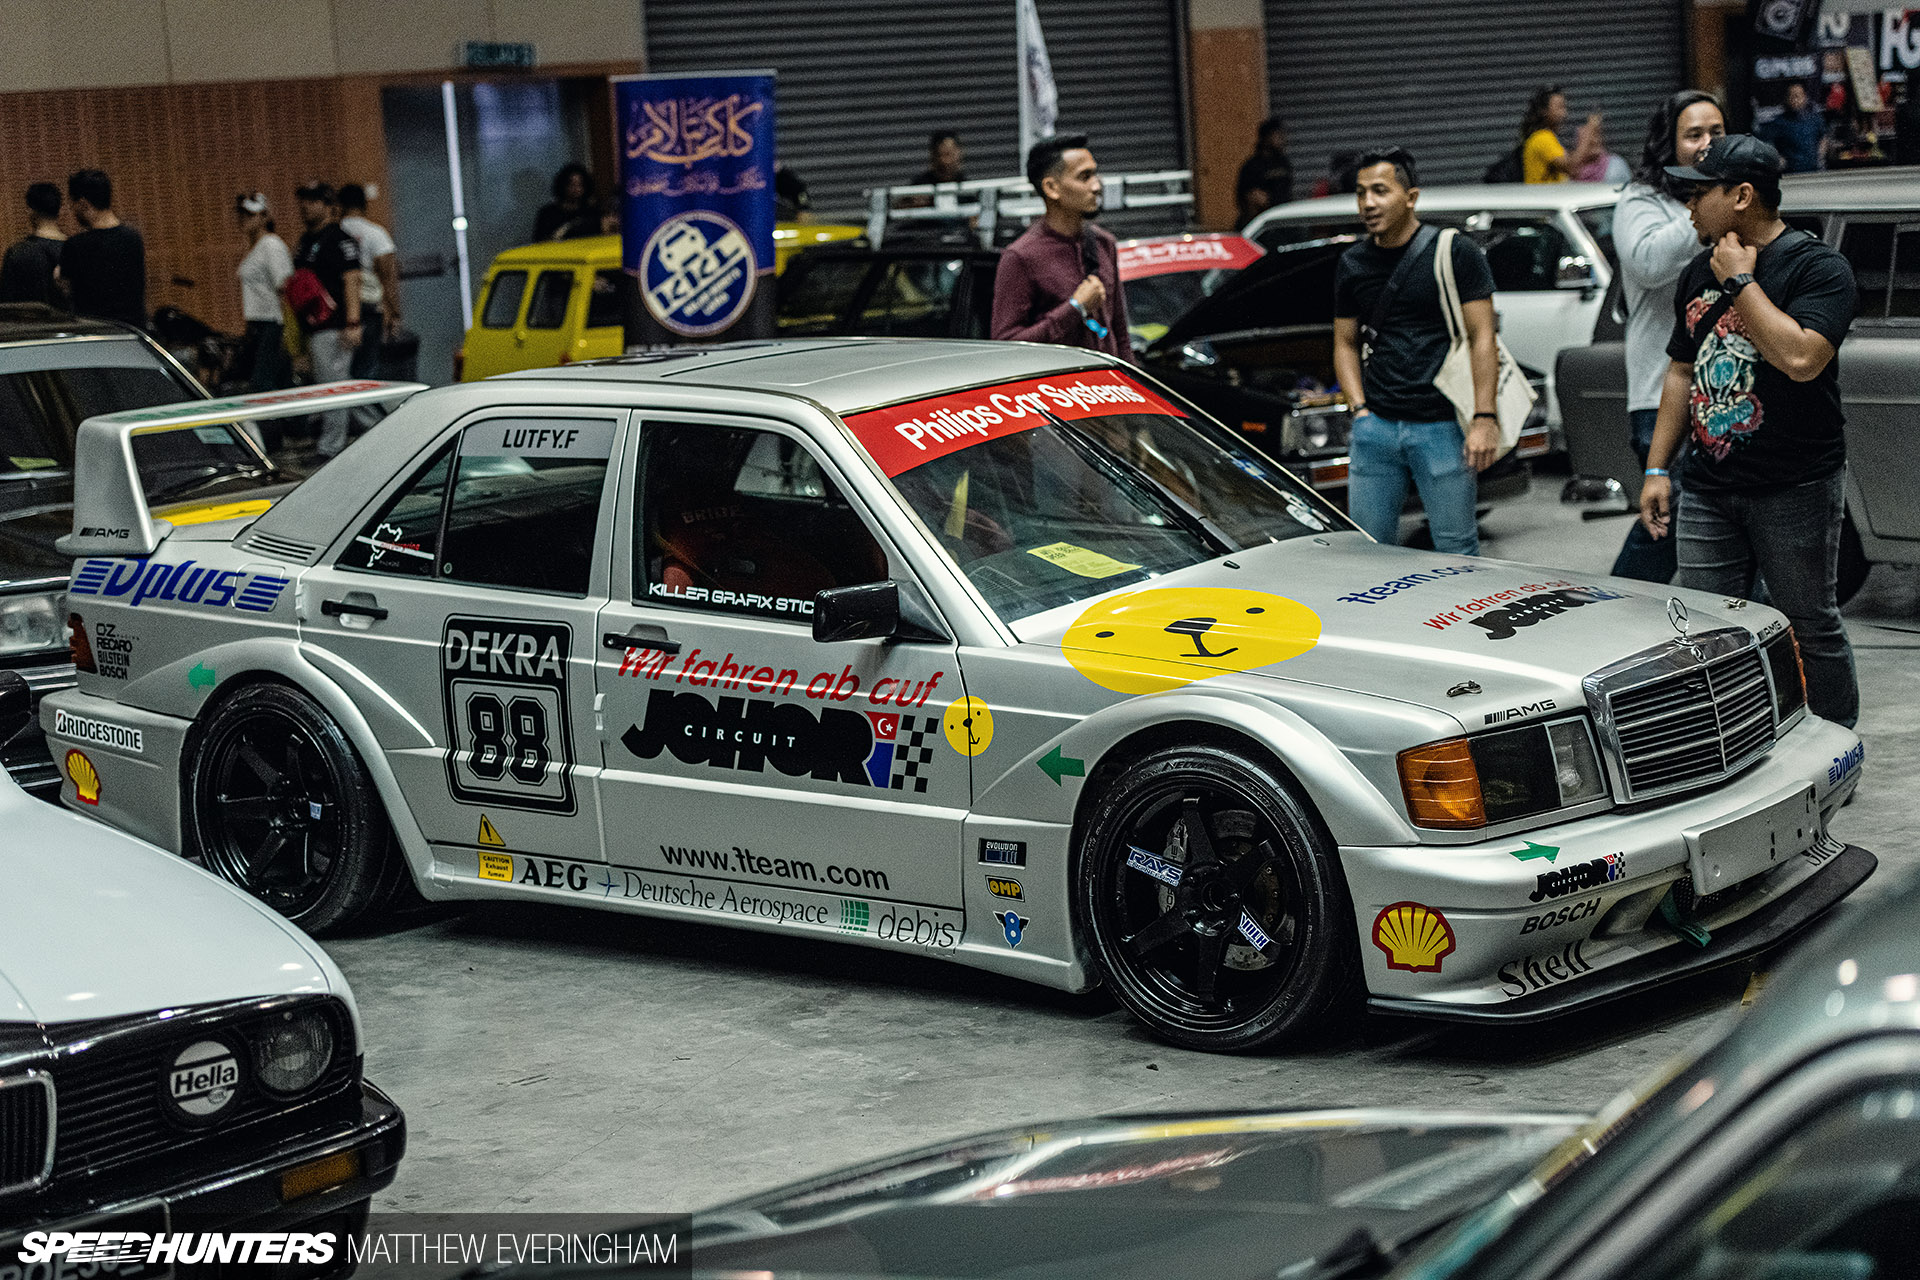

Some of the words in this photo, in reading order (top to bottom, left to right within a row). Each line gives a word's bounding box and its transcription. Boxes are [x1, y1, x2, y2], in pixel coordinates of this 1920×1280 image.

[894, 402, 1004, 451] Philips
[989, 389, 1051, 420] Car
[1038, 380, 1146, 412] Systems
[501, 428, 579, 449] LUTFY.F
[94, 527, 131, 539] AMG
[102, 555, 248, 607] Dplus
[649, 582, 709, 602] KILLER
[711, 590, 773, 611] GRAFIX
[1422, 604, 1464, 631] Wir
[1454, 587, 1521, 616] fahren
[96, 636, 133, 651] RECARO
[97, 650, 131, 667] BILSTEIN
[445, 629, 564, 680] DEKRA
[99, 666, 129, 680] BOSCH
[618, 646, 676, 682] Wir
[676, 648, 800, 696] fahren
[805, 664, 861, 702] ab
[868, 670, 945, 709] auf
[1506, 699, 1558, 721] AMG
[57, 712, 142, 750] BRIDGESTONE
[466, 692, 552, 786] 88
[620, 687, 877, 788] JOHOR
[684, 724, 797, 748] CIRCUIT
[482, 855, 511, 864] CAUTION
[519, 857, 589, 892] AEG
[1129, 849, 1183, 881] RAYS
[989, 879, 1021, 897] OMP
[1528, 857, 1611, 903] JOHOR
[1551, 872, 1589, 888] CIRCUIT
[623, 871, 716, 909] Deutsche
[719, 885, 829, 925] Aerospace
[877, 906, 958, 948] debis
[1519, 897, 1602, 936] BOSCH
[1497, 938, 1595, 1001] Shell
[174, 1065, 236, 1095] Hella
